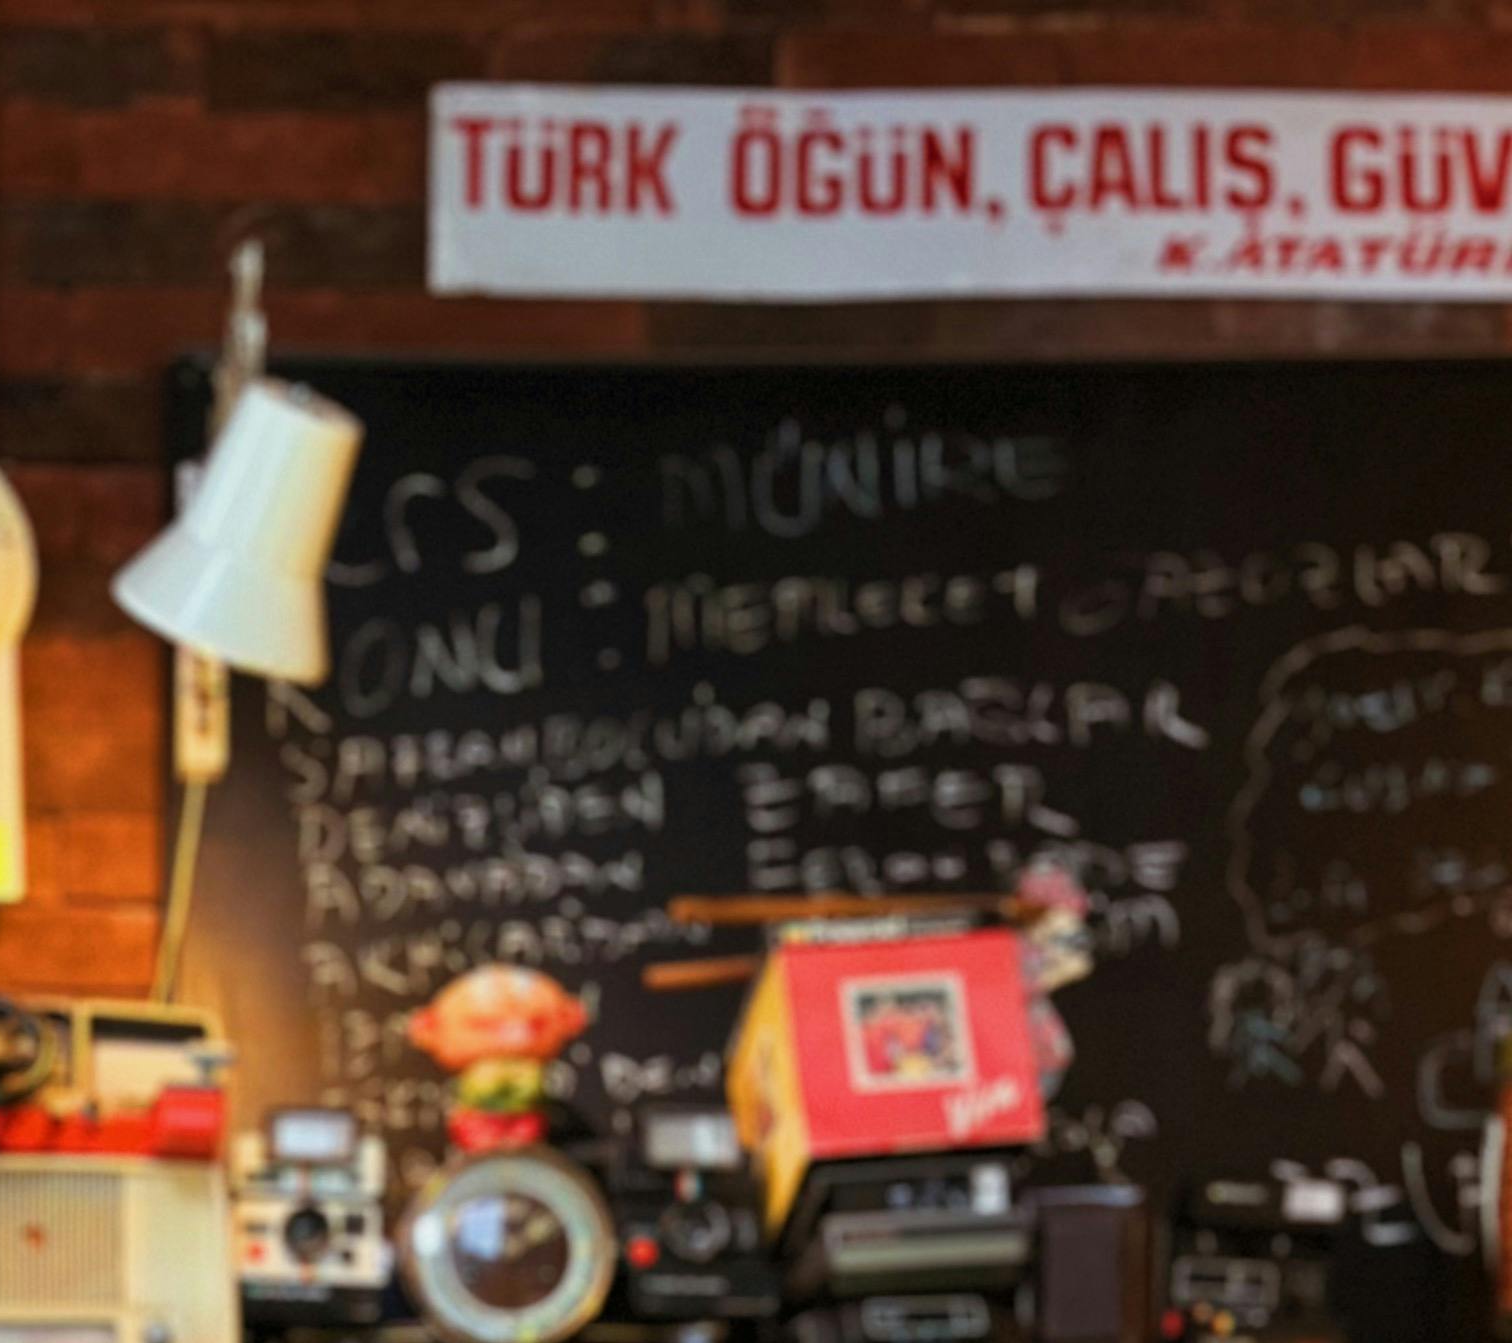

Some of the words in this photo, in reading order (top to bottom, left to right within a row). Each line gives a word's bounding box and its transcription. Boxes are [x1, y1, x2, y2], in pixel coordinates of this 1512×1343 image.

[448, 113, 681, 216] TÜRK
[727, 104, 1006, 230] ÖĞÜN,
[1028, 122, 1307, 238] ÇALIŞ,
[1156, 230, 1512, 276] K.ATATÜR
